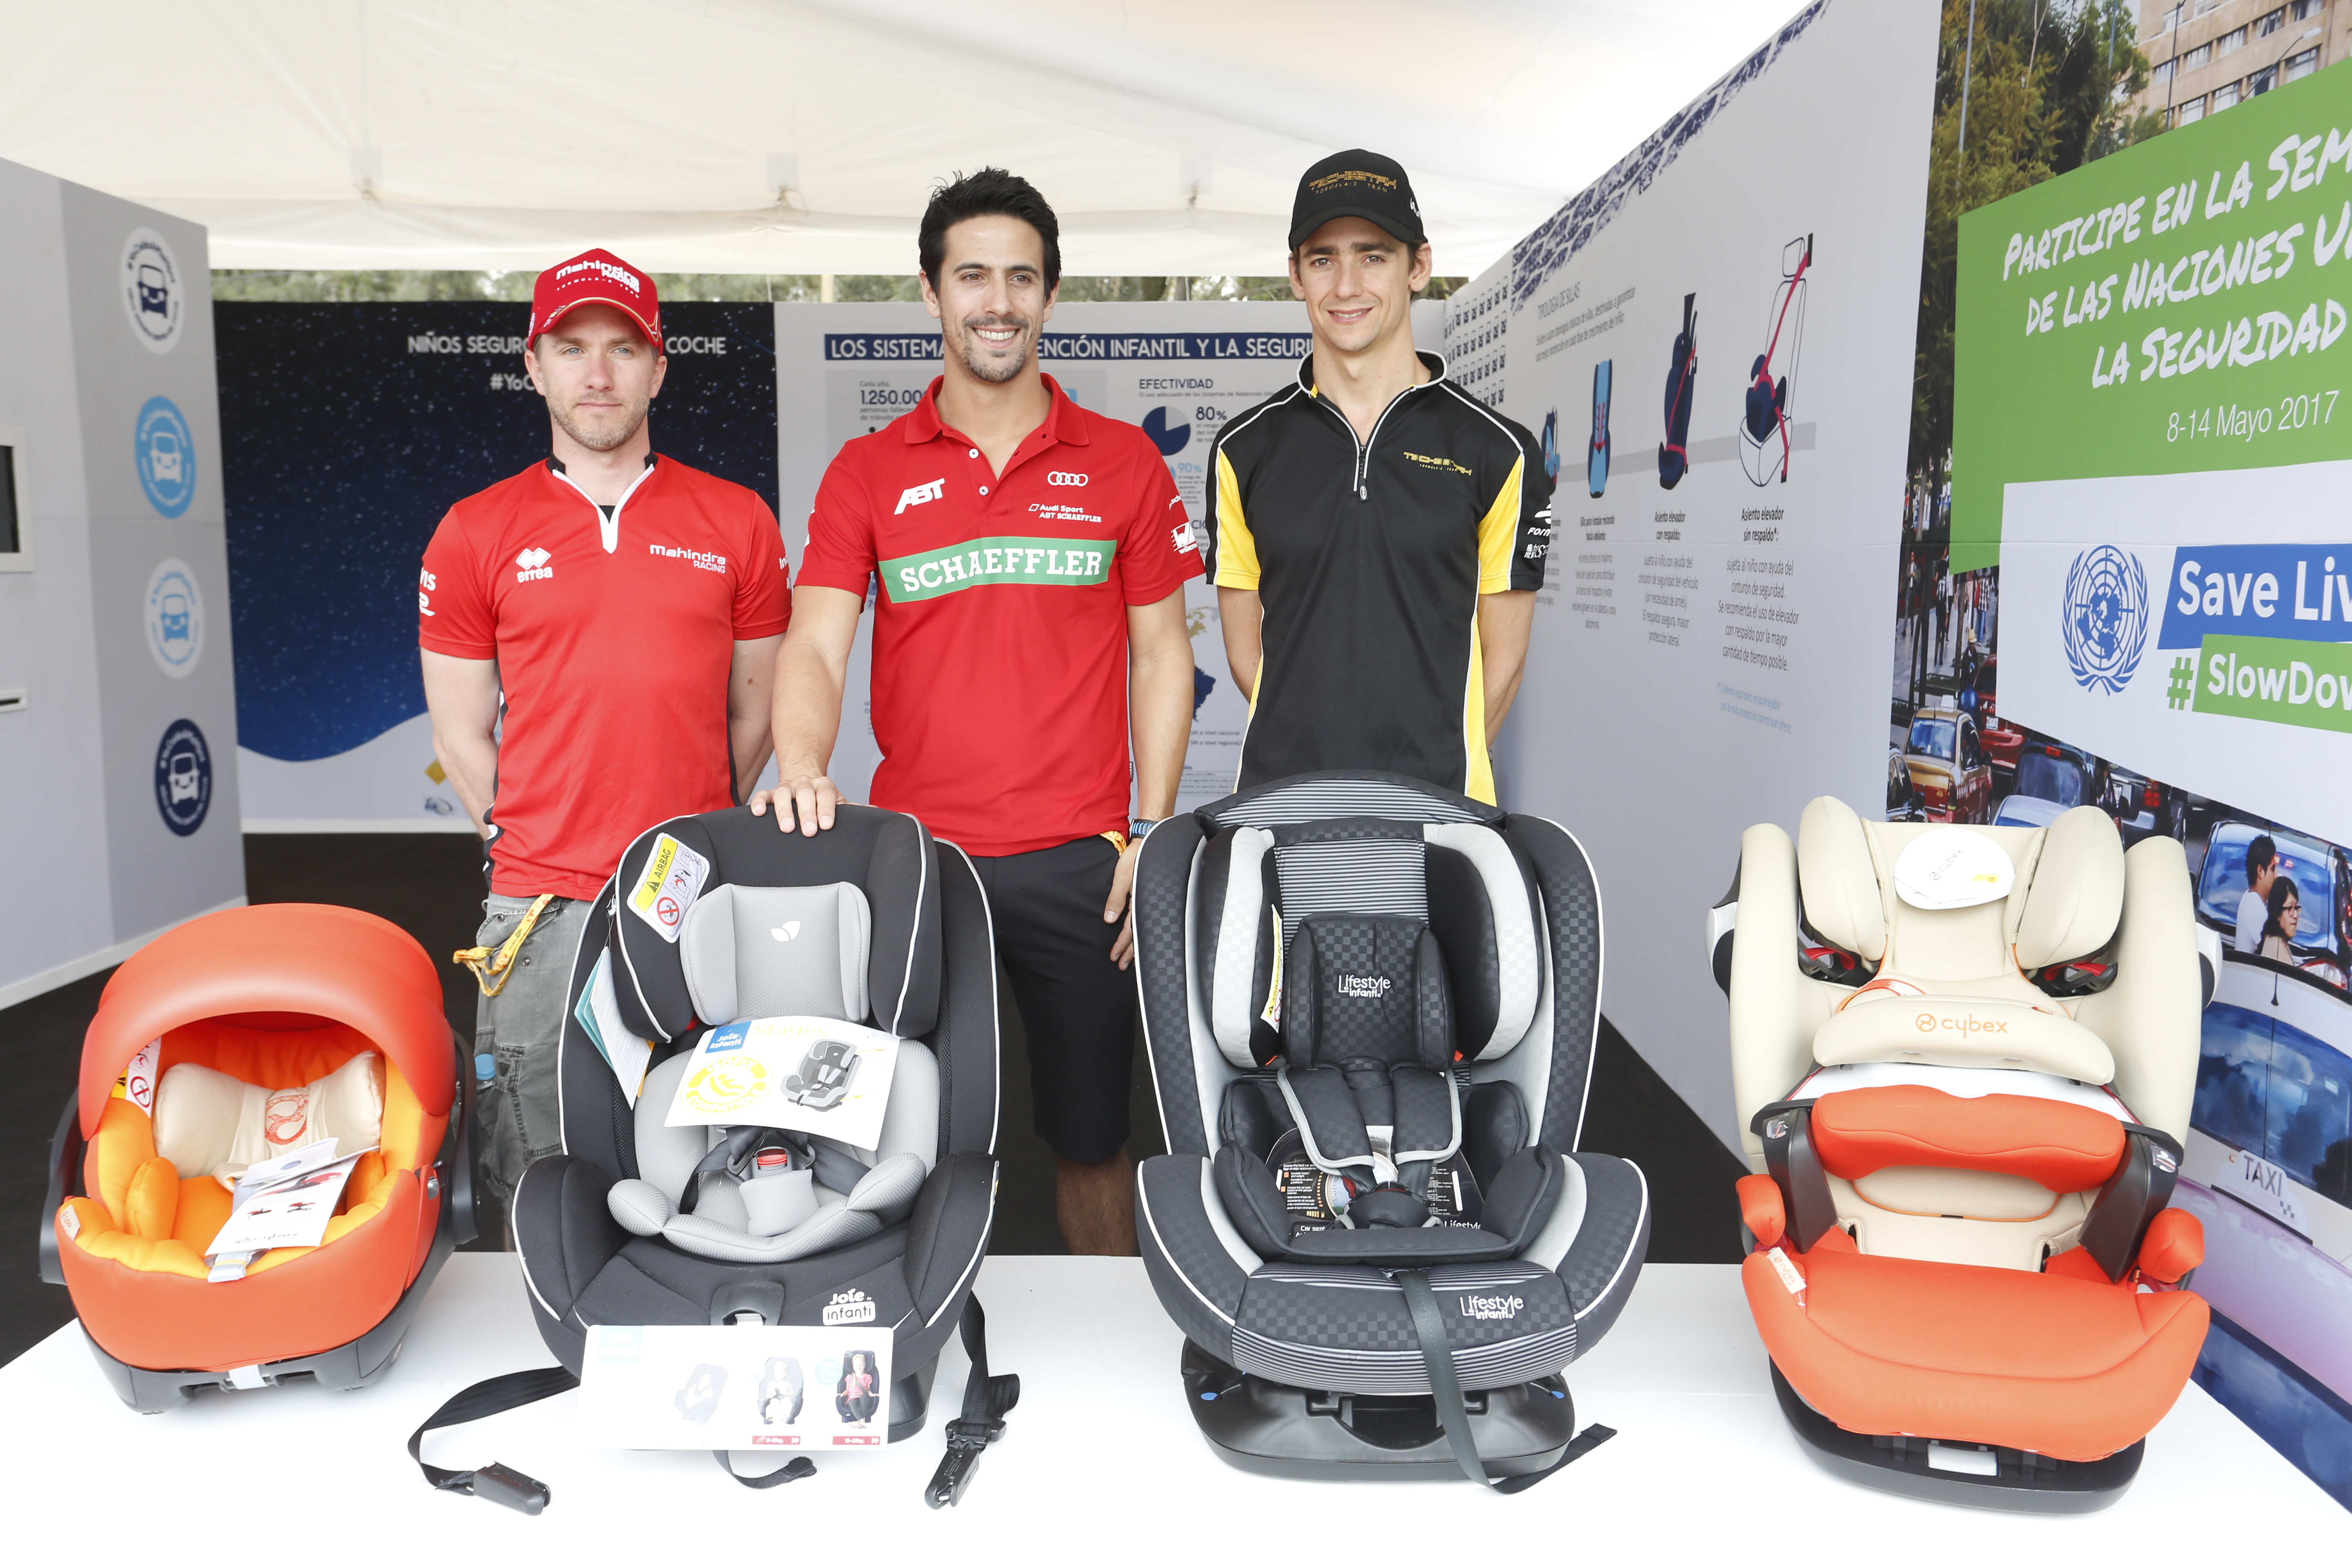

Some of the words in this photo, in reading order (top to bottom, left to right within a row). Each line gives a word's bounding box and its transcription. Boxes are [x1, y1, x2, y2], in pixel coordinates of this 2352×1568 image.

[2004, 196, 2145, 281] PARTICIPE
[2152, 179, 2197, 235] EN
[2205, 161, 2253, 220] LA
[601, 270, 640, 293] RACING
[2026, 291, 2058, 336] DE
[2063, 274, 2118, 327] LAS
[2123, 222, 2304, 313] NACIONES
[620, 284, 639, 298] TEAM
[408, 331, 462, 354] NIÑOS
[666, 336, 726, 354] COCHE
[831, 339, 867, 358] LOS
[1110, 339, 1190, 358] INFANTIL
[1196, 339, 1210, 357] Y
[1215, 339, 1240, 357] LA
[2092, 341, 2129, 389] LA
[2140, 298, 2347, 382] SEGURIDAD
[1139, 379, 1213, 389] EFECTIVIDAD
[1196, 406, 1227, 420] 80%
[2167, 406, 2210, 442] 8-14
[2216, 403, 2272, 443] Mayo
[2278, 390, 2340, 432] 2017
[1178, 462, 1202, 473] 90%
[894, 478, 945, 515] ABT
[1039, 503, 1059, 512] Audi
[1060, 505, 1083, 514] Sport
[1057, 512, 1102, 523] SCHAEFFLER
[1669, 510, 1686, 522] elevador
[1741, 507, 1760, 521] Asiento
[1761, 506, 1784, 521] elevador
[694, 560, 726, 574] RACING
[900, 548, 1102, 592] SCHAEFFLER
[1727, 557, 1741, 573] sujeta
[1742, 557, 1746, 571] al
[1747, 558, 1757, 573] niño
[1759, 561, 1767, 573] con
[1768, 559, 1784, 577] ayuda
[1785, 560, 1793, 575] del
[1732, 579, 1751, 594] cinturón
[1752, 581, 1758, 596] de
[1759, 583, 1785, 599] seguridad.
[2176, 559, 2279, 618] Save
[1718, 600, 1724, 613] Se
[1725, 602, 1752, 618] recomienda
[1753, 604, 1757, 618] el
[1758, 608, 1767, 619] uso
[1768, 605, 1775, 620] de
[1776, 607, 1799, 624] elevador
[1726, 625, 1734, 636] con
[1735, 625, 1755, 641] respaldo
[1756, 630, 1765, 644] por
[1766, 628, 1770, 643] la
[1771, 633, 1788, 648] mayor
[1723, 645, 1742, 660] cantidad
[1743, 647, 1749, 662] de
[1750, 649, 1768, 668] tiempo
[1768, 654, 1788, 671] posible.
[654, 848, 671, 879] AIRBAG
[1939, 849, 1963, 871] cybex
[1338, 974, 1391, 994] Lifestyle
[1349, 988, 1378, 998] infanti
[753, 1025, 827, 1038] Stages
[1941, 1013, 2009, 1038] cybex
[710, 1038, 742, 1049] infanti
[706, 1057, 757, 1072] ISOFIX
[688, 1088, 762, 1112] COMPATIBLE
[2244, 1155, 2282, 1197] TAXI
[254, 1233, 299, 1241] cybex
[1780, 1263, 1797, 1283] cybex
[827, 1305, 871, 1321] infanti
[1459, 1295, 1525, 1316] Lifestyle
[1475, 1309, 1510, 1320] infanti
